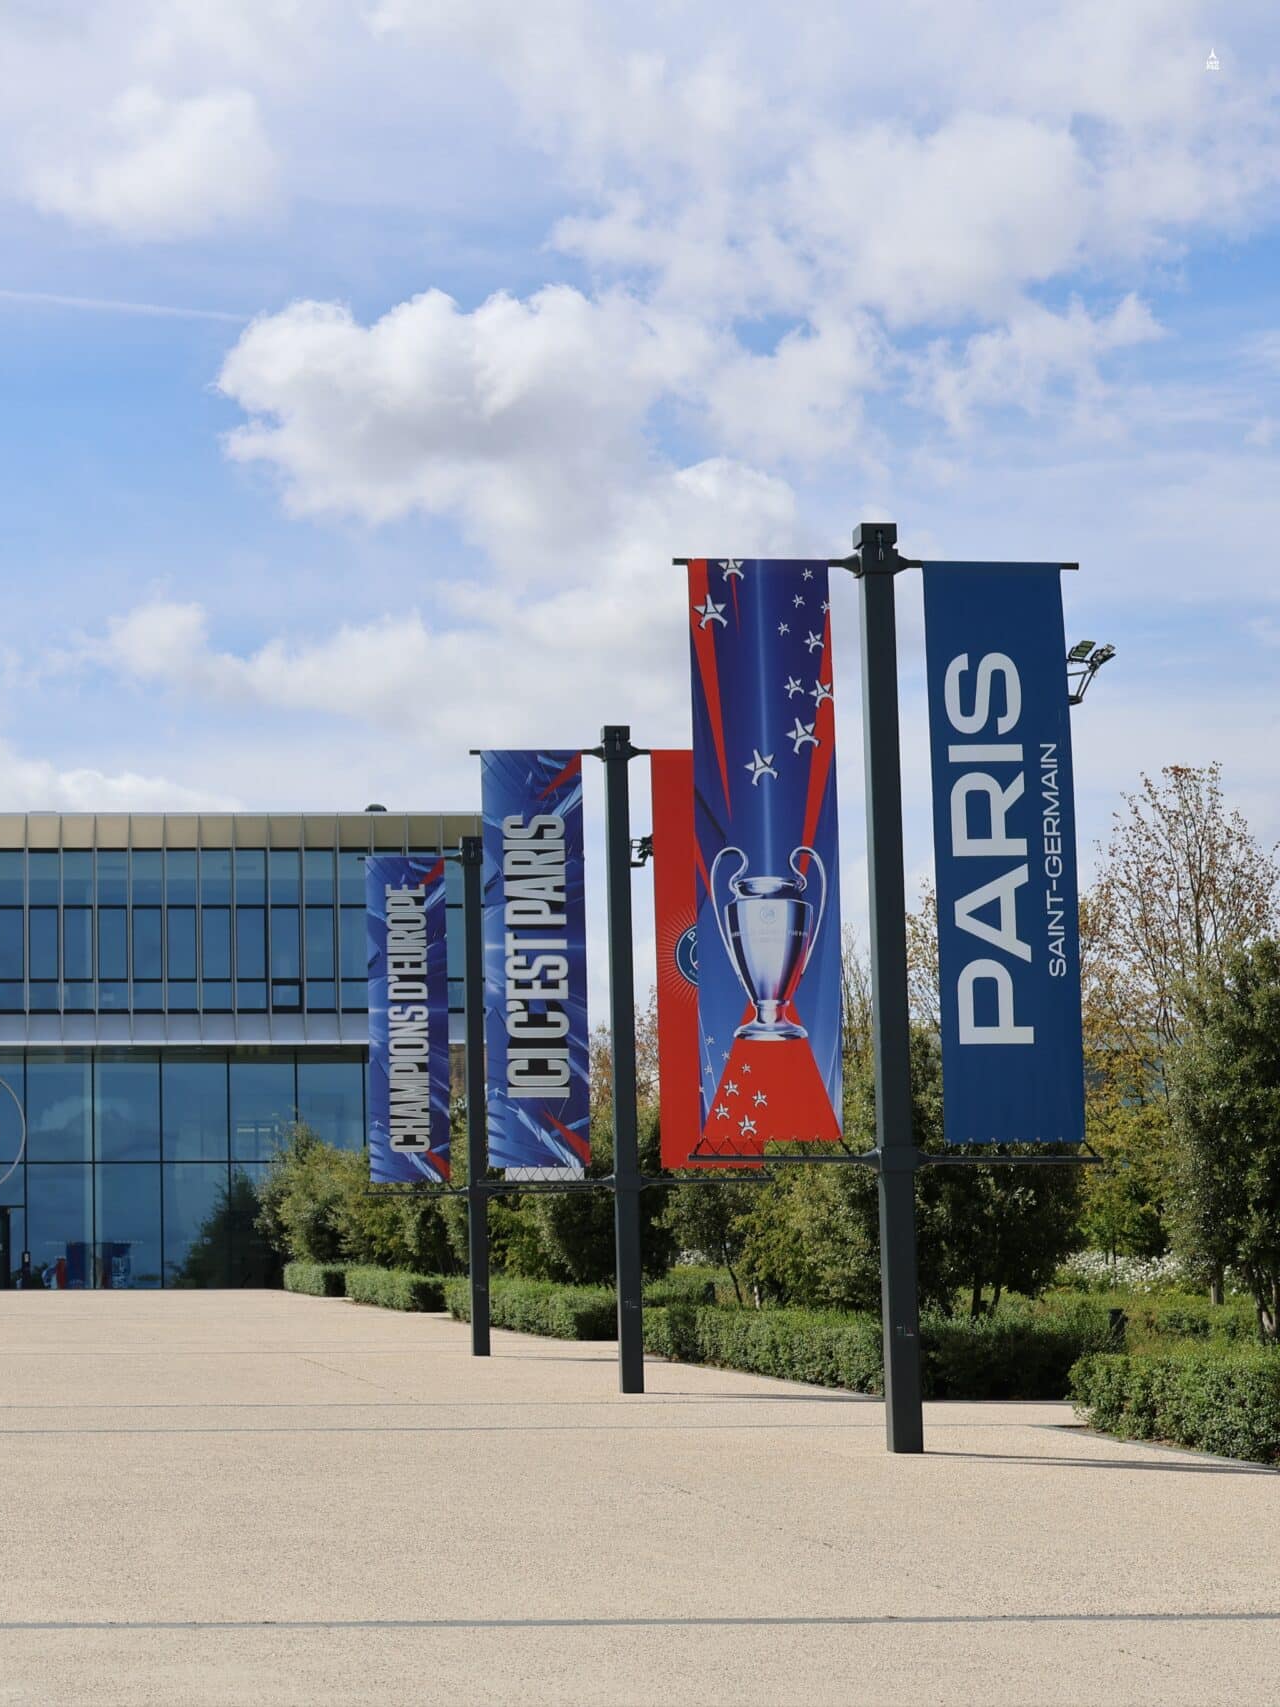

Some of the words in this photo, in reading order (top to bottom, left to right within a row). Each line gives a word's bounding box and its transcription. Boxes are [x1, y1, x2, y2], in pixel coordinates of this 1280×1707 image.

[502, 814, 567, 925] PARIS
[944, 652, 1035, 1044] PARIS
[1040, 743, 1066, 977] SAINT-GERMAIN
[385, 884, 428, 1000] D'EUROPE
[504, 932, 570, 1039] C'EST
[388, 1005, 431, 1153] CHAMPIONS
[506, 1048, 570, 1098] ICI
